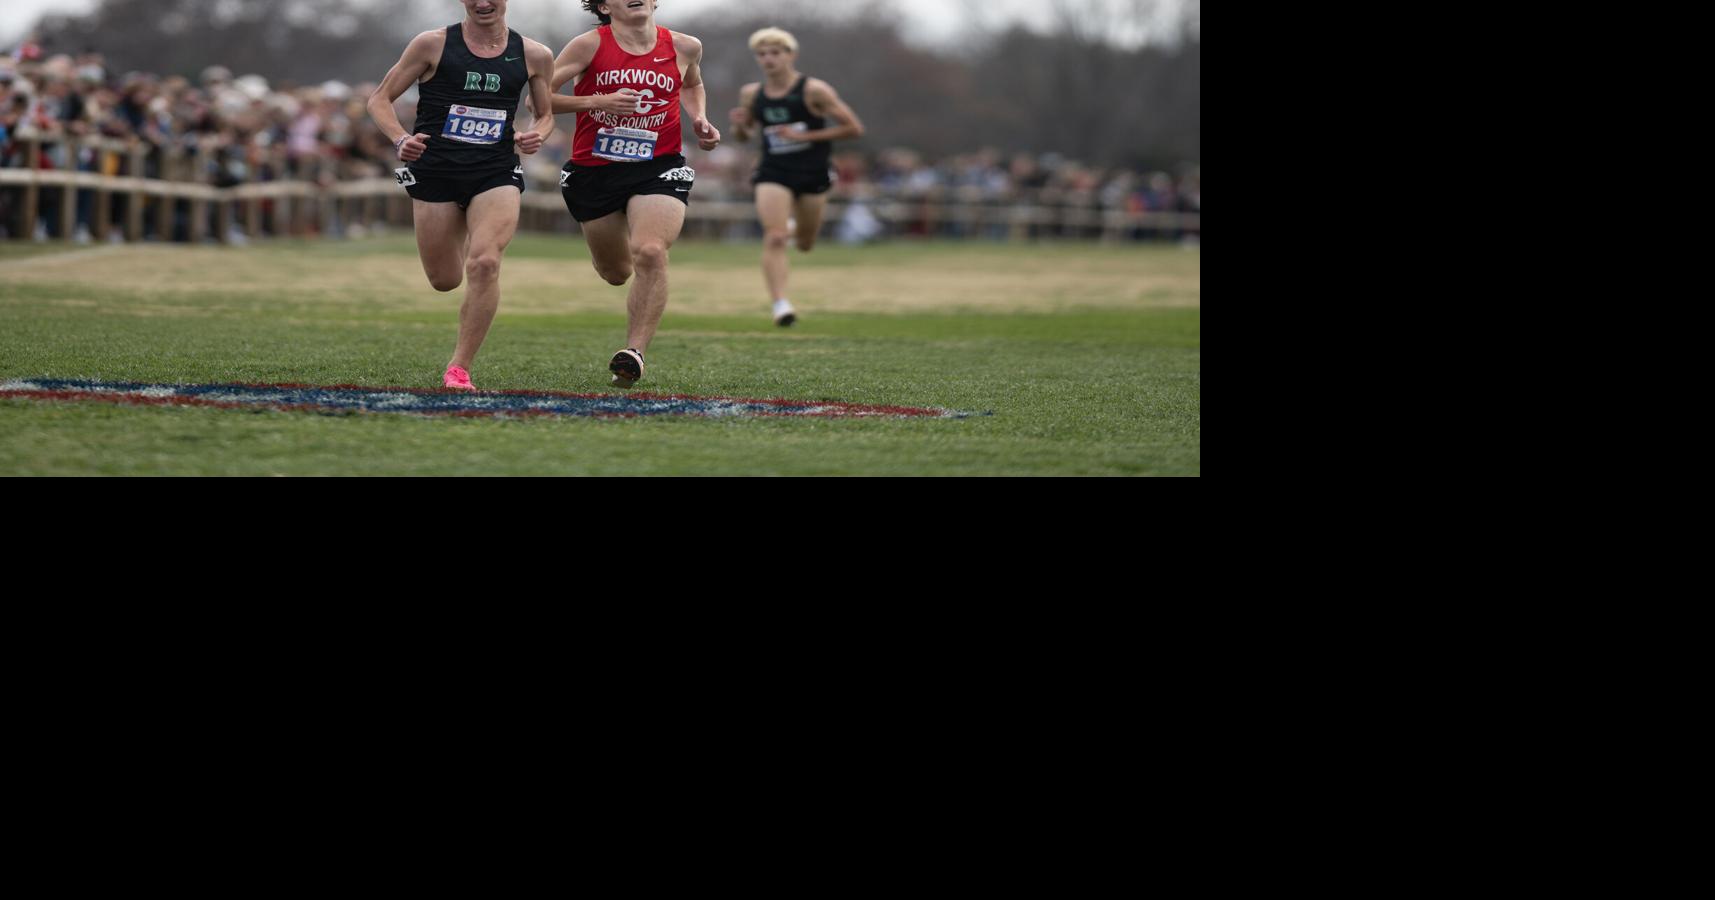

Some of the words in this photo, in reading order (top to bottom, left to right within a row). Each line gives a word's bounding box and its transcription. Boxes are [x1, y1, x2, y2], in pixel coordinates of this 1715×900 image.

[463, 71, 501, 93] RB
[596, 68, 675, 92] KIRKWOOD
[449, 117, 502, 139] 1994
[620, 110, 668, 129] COUNTRY
[598, 137, 653, 158] 1886
